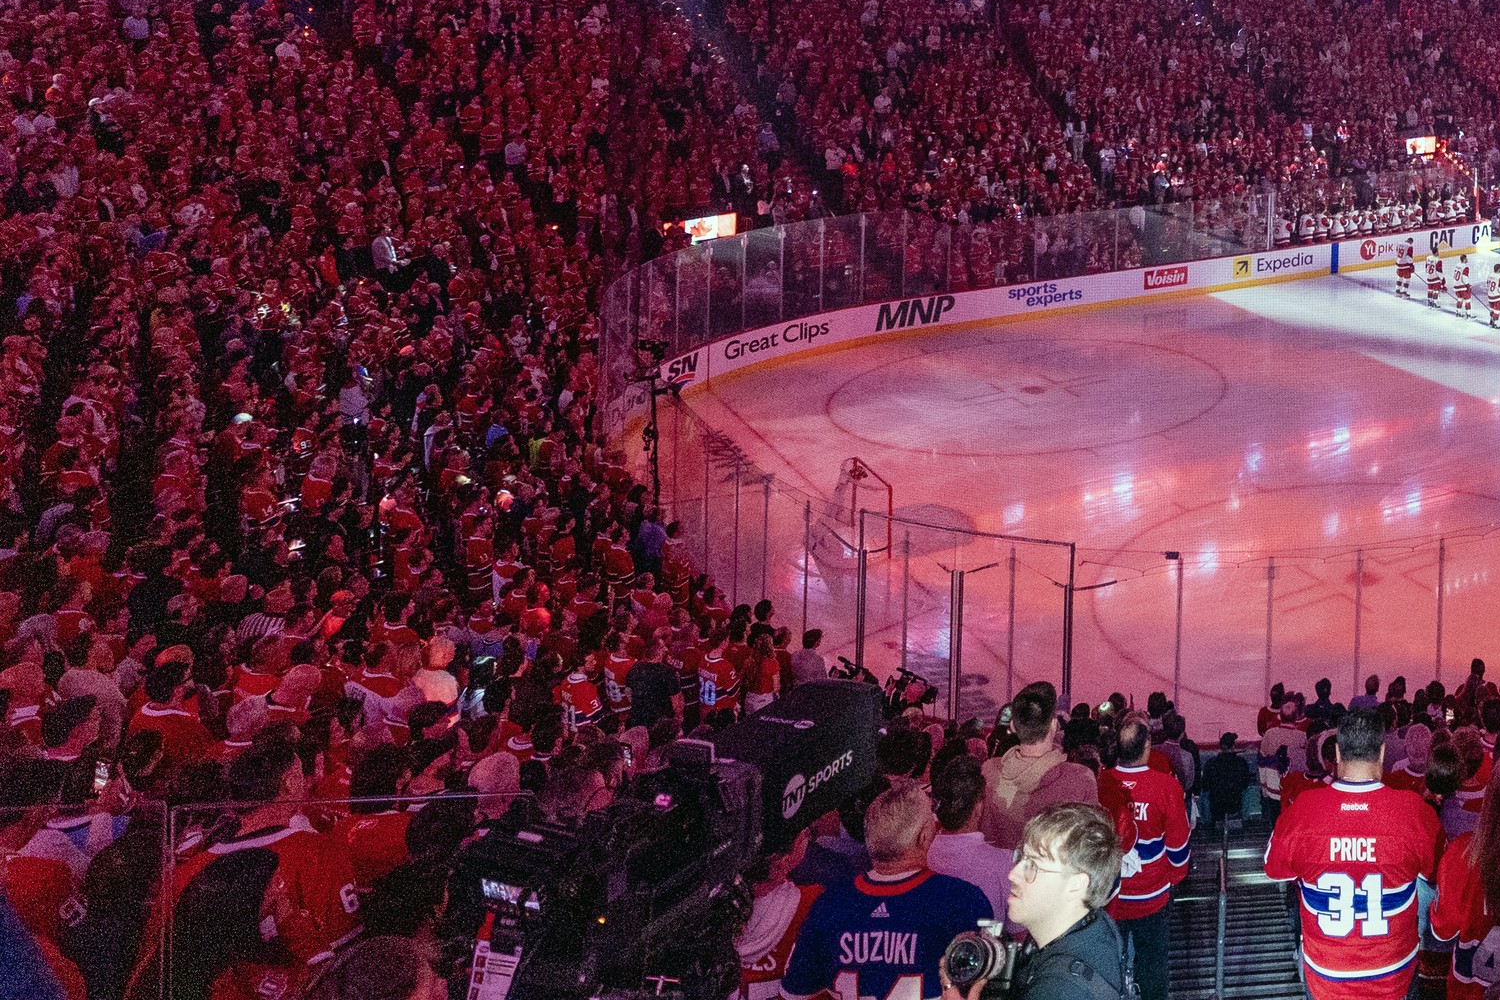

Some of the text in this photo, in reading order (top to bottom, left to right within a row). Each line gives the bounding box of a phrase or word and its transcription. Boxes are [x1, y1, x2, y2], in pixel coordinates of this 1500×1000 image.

[1430, 229, 1455, 250] CAT
[1472, 225, 1491, 244] CA
[1256, 252, 1314, 273] Expedia
[1147, 268, 1187, 287] Voisin
[1008, 283, 1057, 303] sports
[1026, 288, 1083, 307] experts
[875, 295, 956, 332] MNP
[724, 322, 830, 360] Great Clips
[667, 352, 699, 381] SN
[808, 750, 853, 793] SPORTS
[1341, 803, 1369, 811] Reebok
[1330, 838, 1377, 862] PRICE
[1317, 872, 1389, 938] 31
[839, 931, 918, 965] SUZUKI
